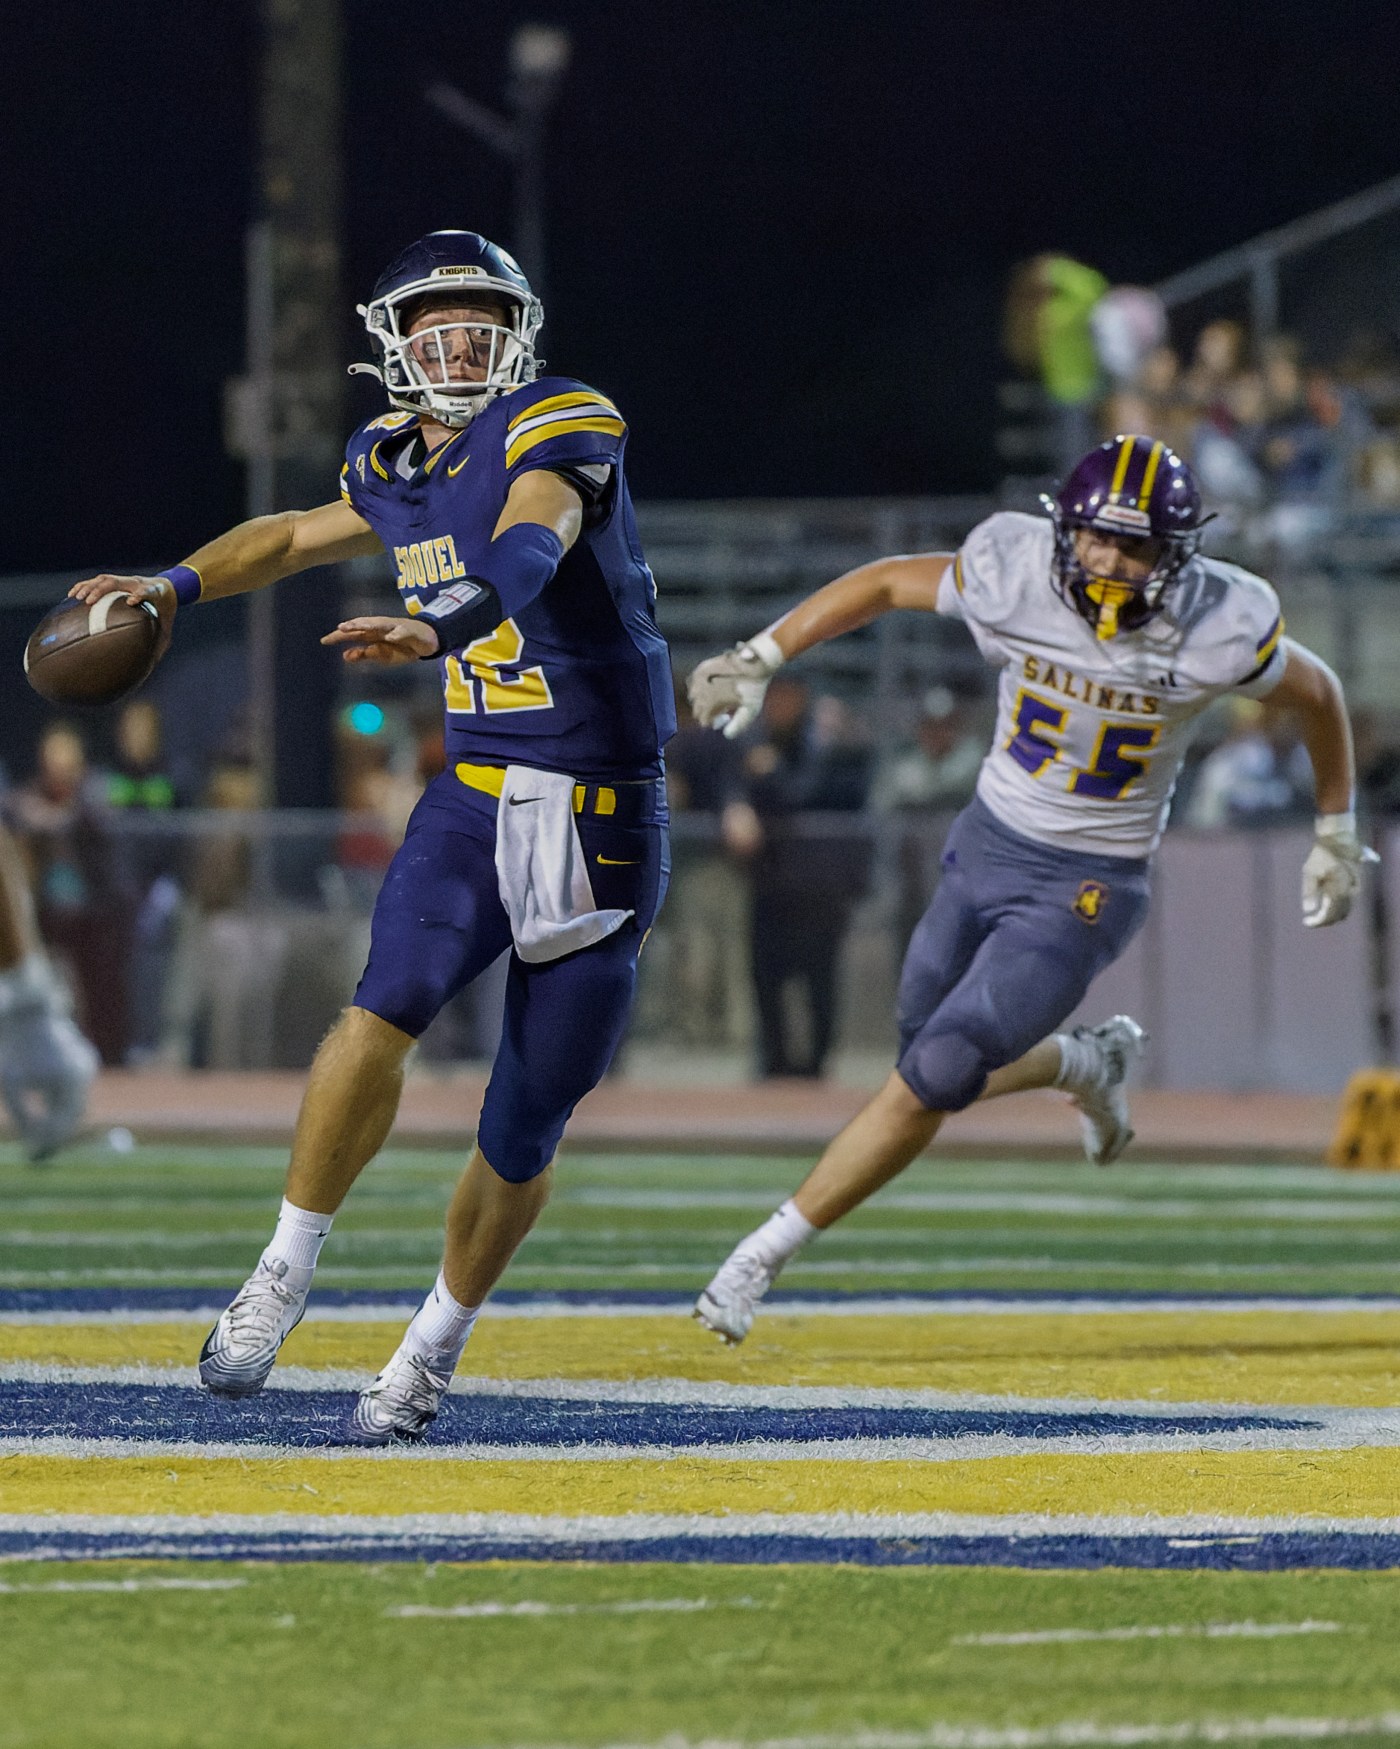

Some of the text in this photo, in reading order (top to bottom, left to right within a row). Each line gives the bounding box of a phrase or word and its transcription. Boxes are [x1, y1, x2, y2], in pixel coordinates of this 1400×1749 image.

[438, 266, 478, 276] KNIGHTS
[393, 534, 466, 589] SOQUEL
[404, 594, 554, 715] 12
[1023, 654, 1159, 714] SALINAS
[1003, 686, 1162, 800] 55
